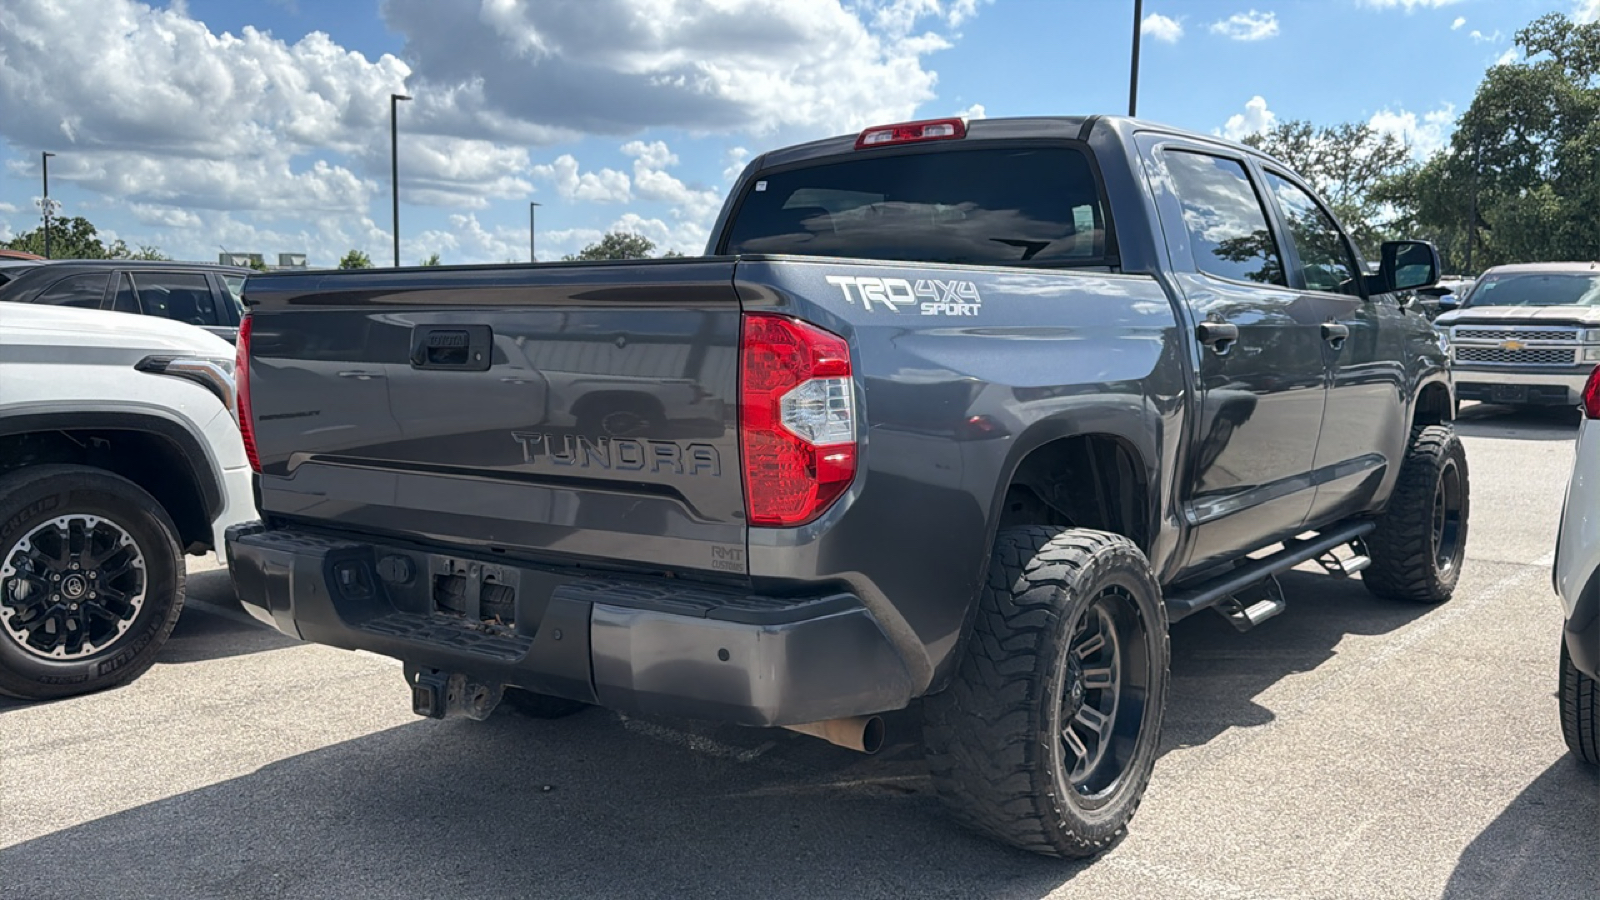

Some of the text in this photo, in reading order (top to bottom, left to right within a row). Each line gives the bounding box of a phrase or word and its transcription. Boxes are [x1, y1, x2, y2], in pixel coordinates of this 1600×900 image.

[825, 275, 917, 313] TRD
[920, 302, 982, 316] SPORT
[429, 334, 464, 346] TOYOTA
[511, 431, 721, 477] TUNDRA
[711, 545, 743, 560] RMT
